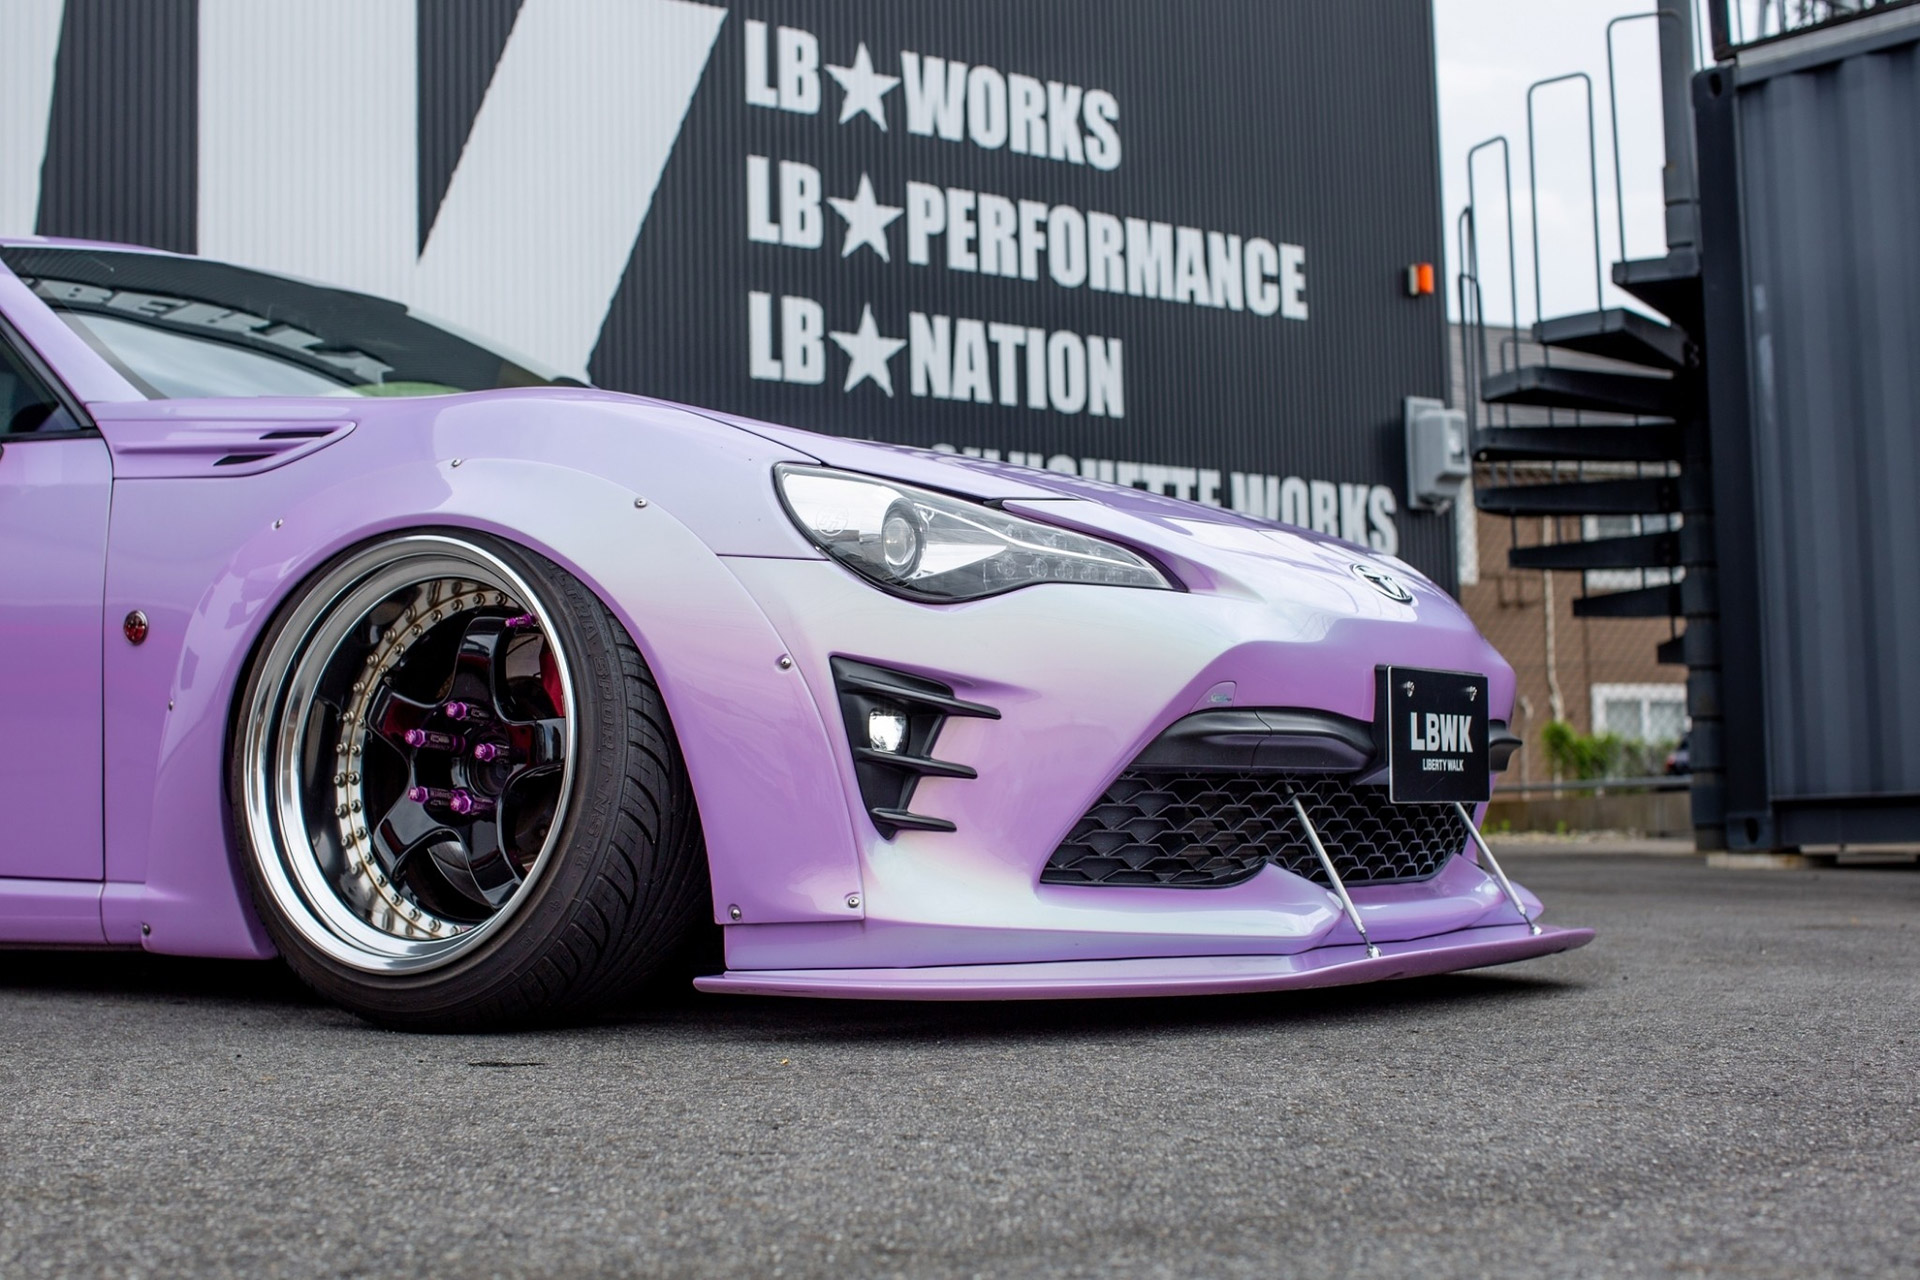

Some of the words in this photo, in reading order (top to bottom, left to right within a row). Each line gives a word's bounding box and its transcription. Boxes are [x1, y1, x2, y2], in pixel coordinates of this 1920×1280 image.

[901, 50, 1122, 171] WORKS
[907, 181, 1309, 321] PERFORMANCE
[909, 312, 1125, 418] NATION
[1410, 711, 1473, 753] LBWK
[1422, 758, 1447, 772] LIBERTY
[1447, 759, 1464, 772] WALK
